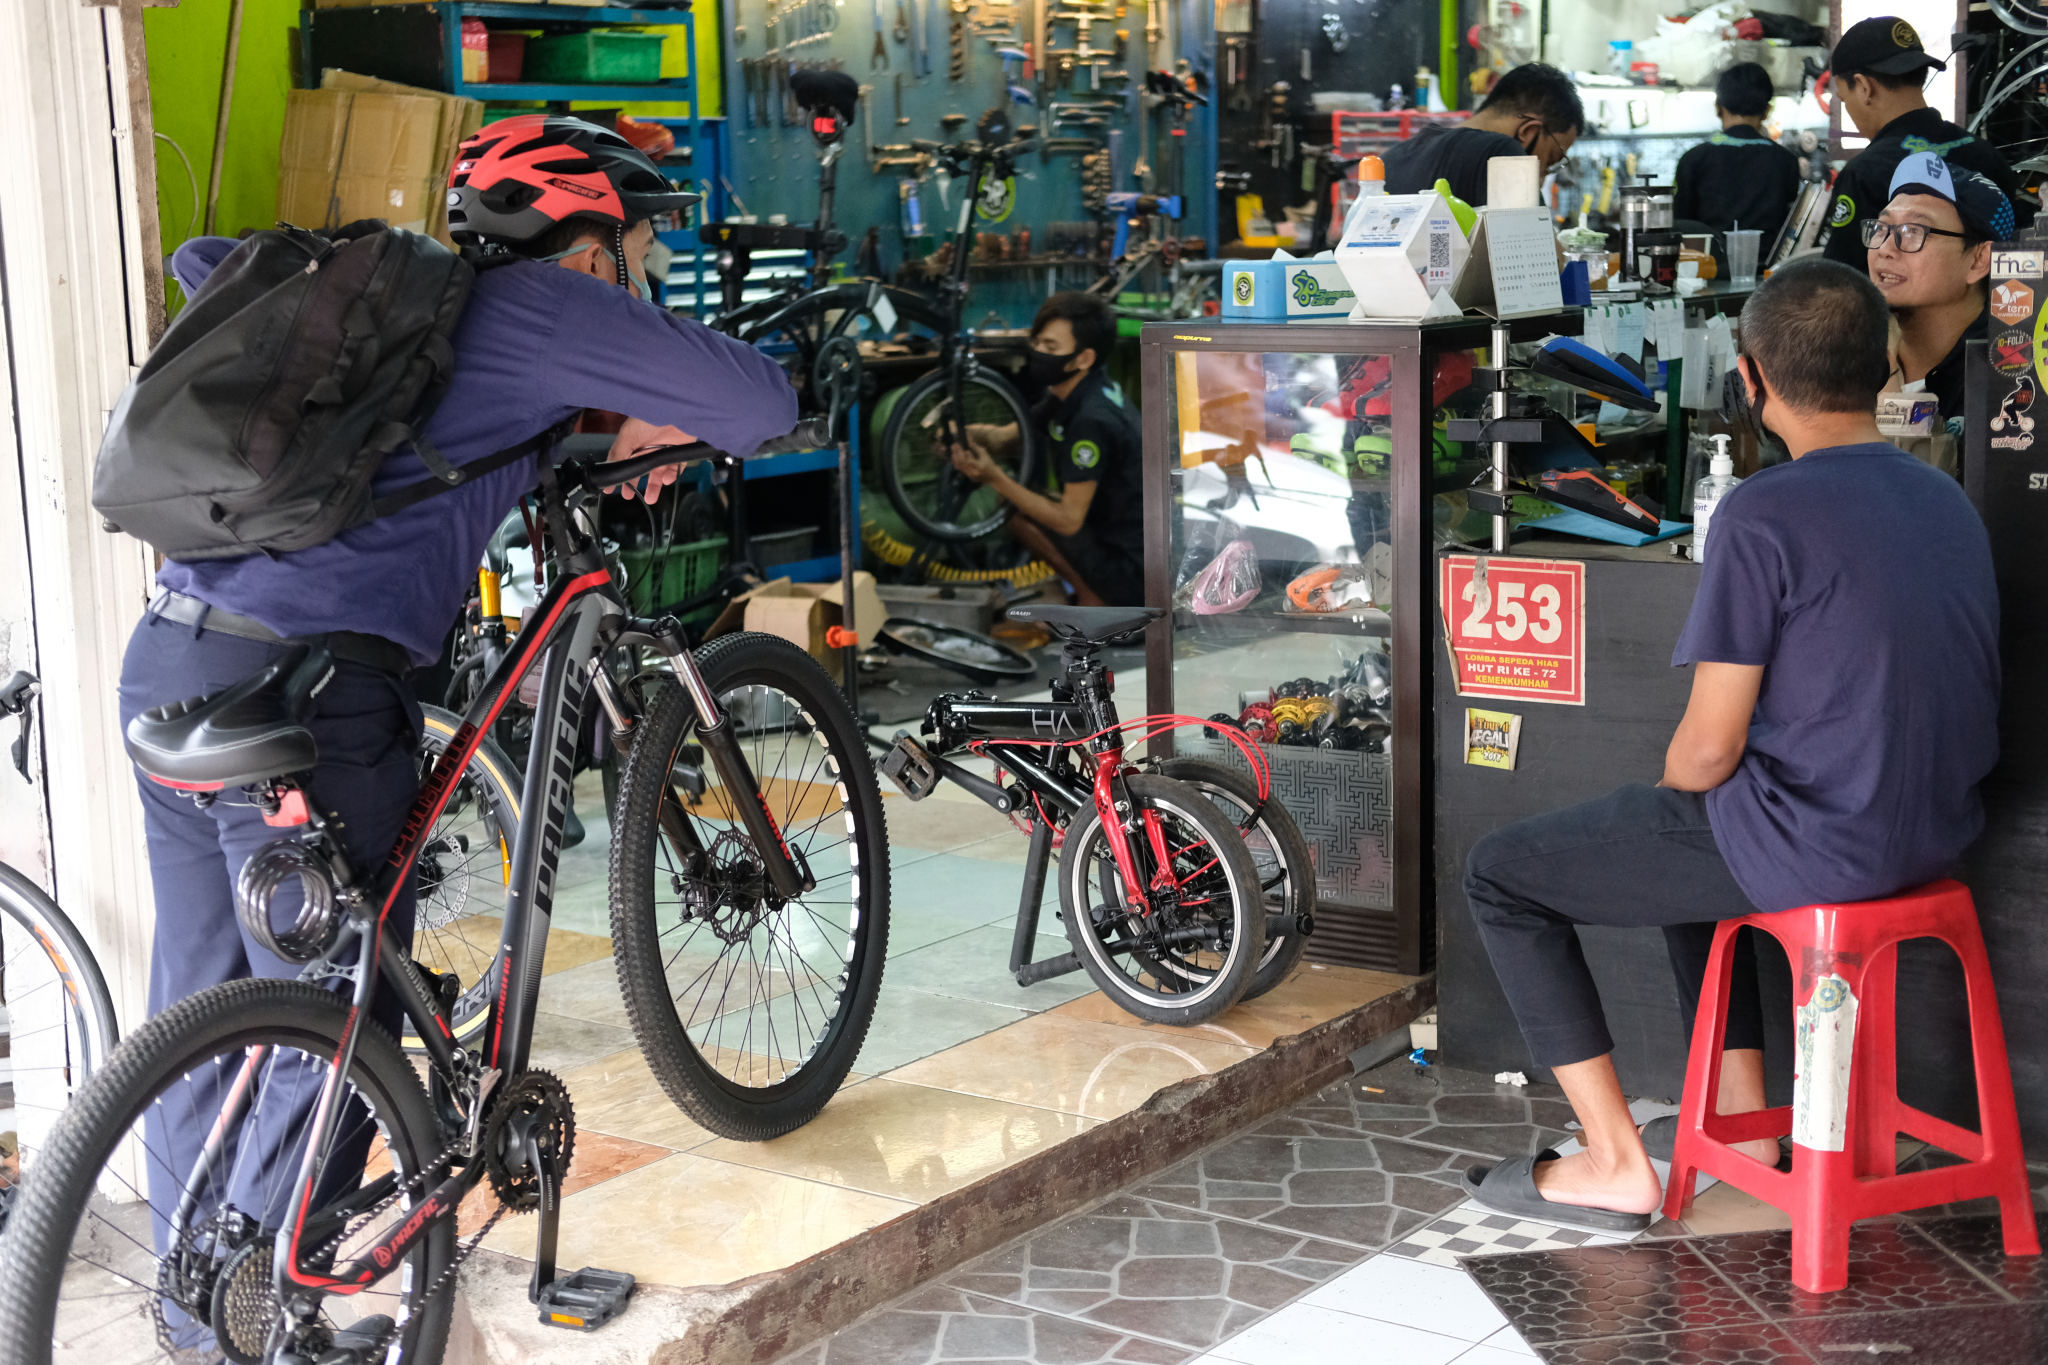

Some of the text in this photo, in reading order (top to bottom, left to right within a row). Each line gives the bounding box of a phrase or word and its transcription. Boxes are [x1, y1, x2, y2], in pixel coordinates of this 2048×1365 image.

[2007, 304, 2030, 313] tern
[1461, 580, 1562, 644] 253
[1465, 653, 1559, 668] LOMBA SEPEDA HIAS
[1467, 663, 1493, 673] HUT
[1497, 665, 1509, 674] RI
[1513, 667, 1531, 676] KE
[1541, 669, 1557, 678] 72
[1475, 674, 1549, 688] KEMENKUMHAM
[535, 657, 586, 917] PACIFIC
[396, 947, 439, 1017] SHIMANO
[390, 1197, 439, 1254] PACIFIC
